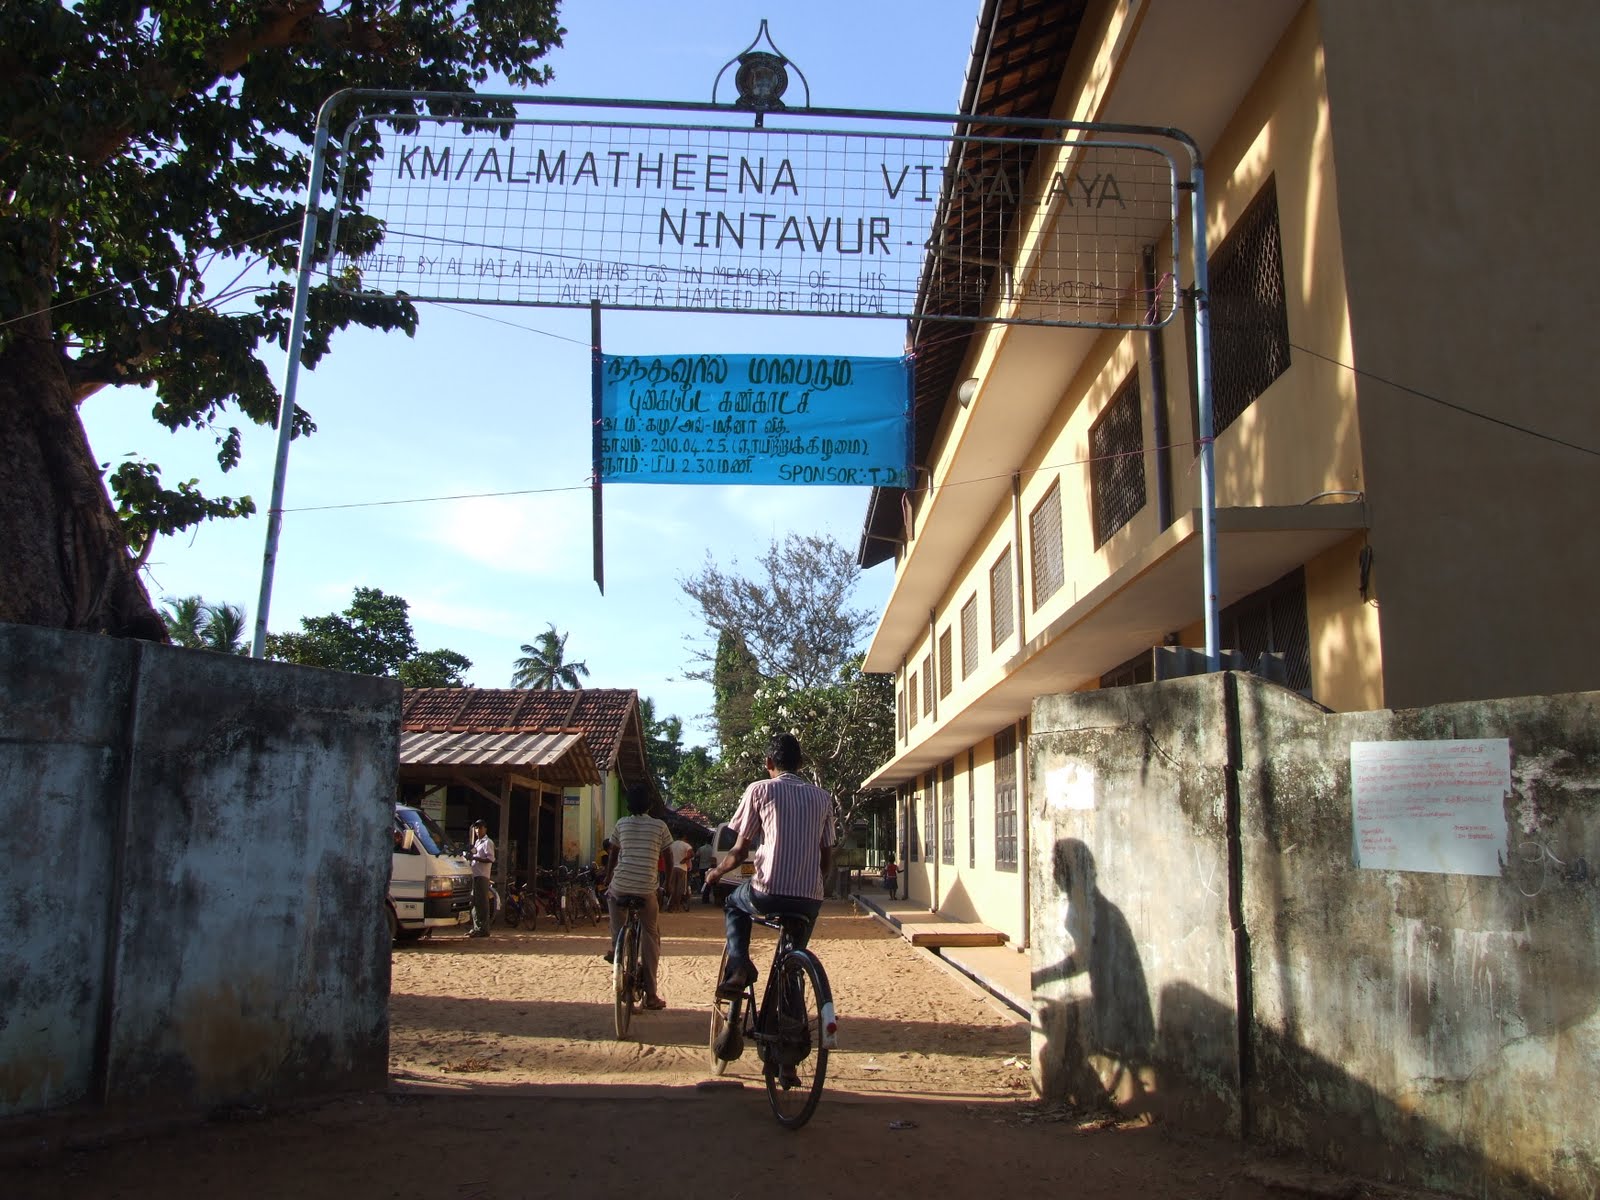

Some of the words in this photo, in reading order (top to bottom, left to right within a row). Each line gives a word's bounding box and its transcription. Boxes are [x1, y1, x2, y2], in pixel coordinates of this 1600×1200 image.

[417, 256, 439, 275] BY
[684, 266, 702, 284] IN
[712, 266, 782, 286] MEMORY
[808, 270, 831, 288] OF
[860, 272, 886, 290] HIS
